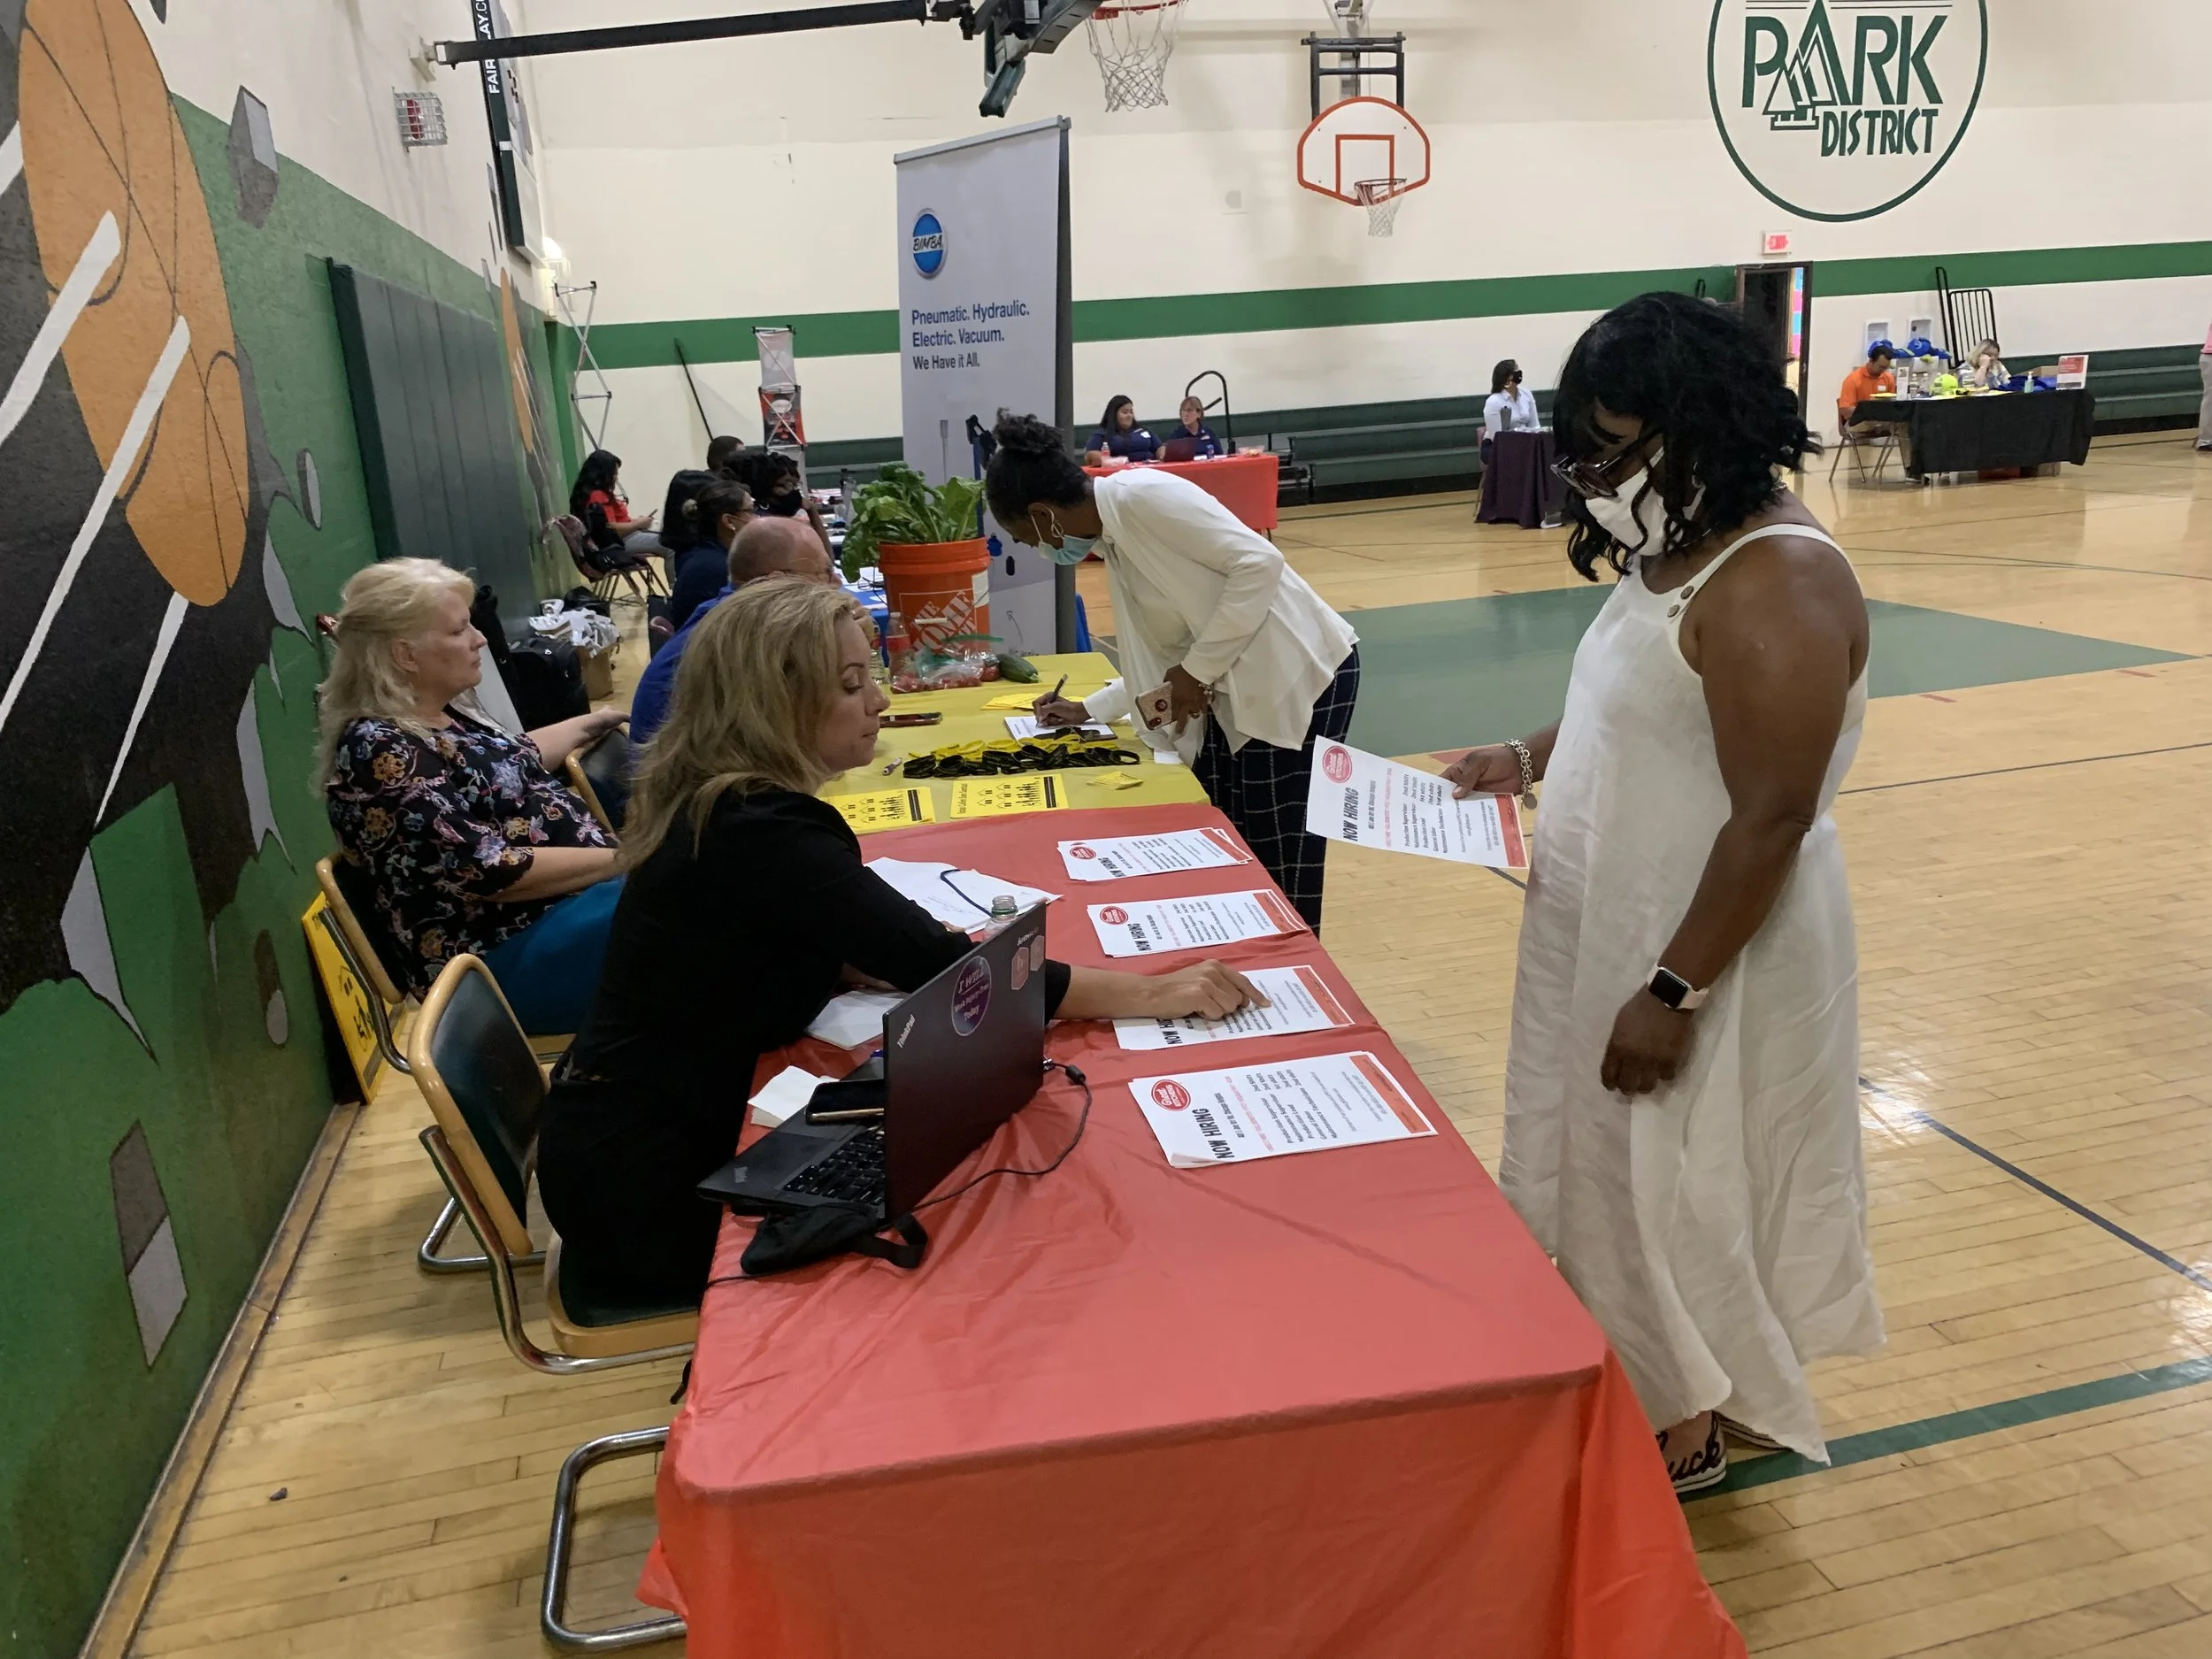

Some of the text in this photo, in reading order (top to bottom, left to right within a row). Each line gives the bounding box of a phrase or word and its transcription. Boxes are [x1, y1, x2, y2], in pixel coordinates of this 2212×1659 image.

[1742, 0, 1947, 107] PARK
[1821, 107, 1939, 157] DISTRICT
[913, 234, 943, 251] BIMBA
[912, 299, 1030, 326] Pneumatic. Hydraulic.
[912, 327, 1005, 347] Electric. Vacuum.
[913, 352, 980, 370] We Have it All.
[1343, 787, 1359, 841] NOW HIRING
[1127, 923, 1146, 939] HIRING
[897, 1014, 916, 1048] ThinkPad
[1162, 1031, 1183, 1044] NOW
[1258, 1097, 1279, 1118] Supervisor
[1267, 1093, 1288, 1115] Supervisor
[1286, 1103, 1298, 1114] Lead
[1192, 1108, 1235, 1159] NOW HIRING
[1272, 1118, 1294, 1143] Production
[1282, 1115, 1305, 1141] Maintenance
[1293, 1114, 1315, 1138] Production
[1310, 1122, 1328, 1139] General
[1314, 1110, 1339, 1138] Maintenance
